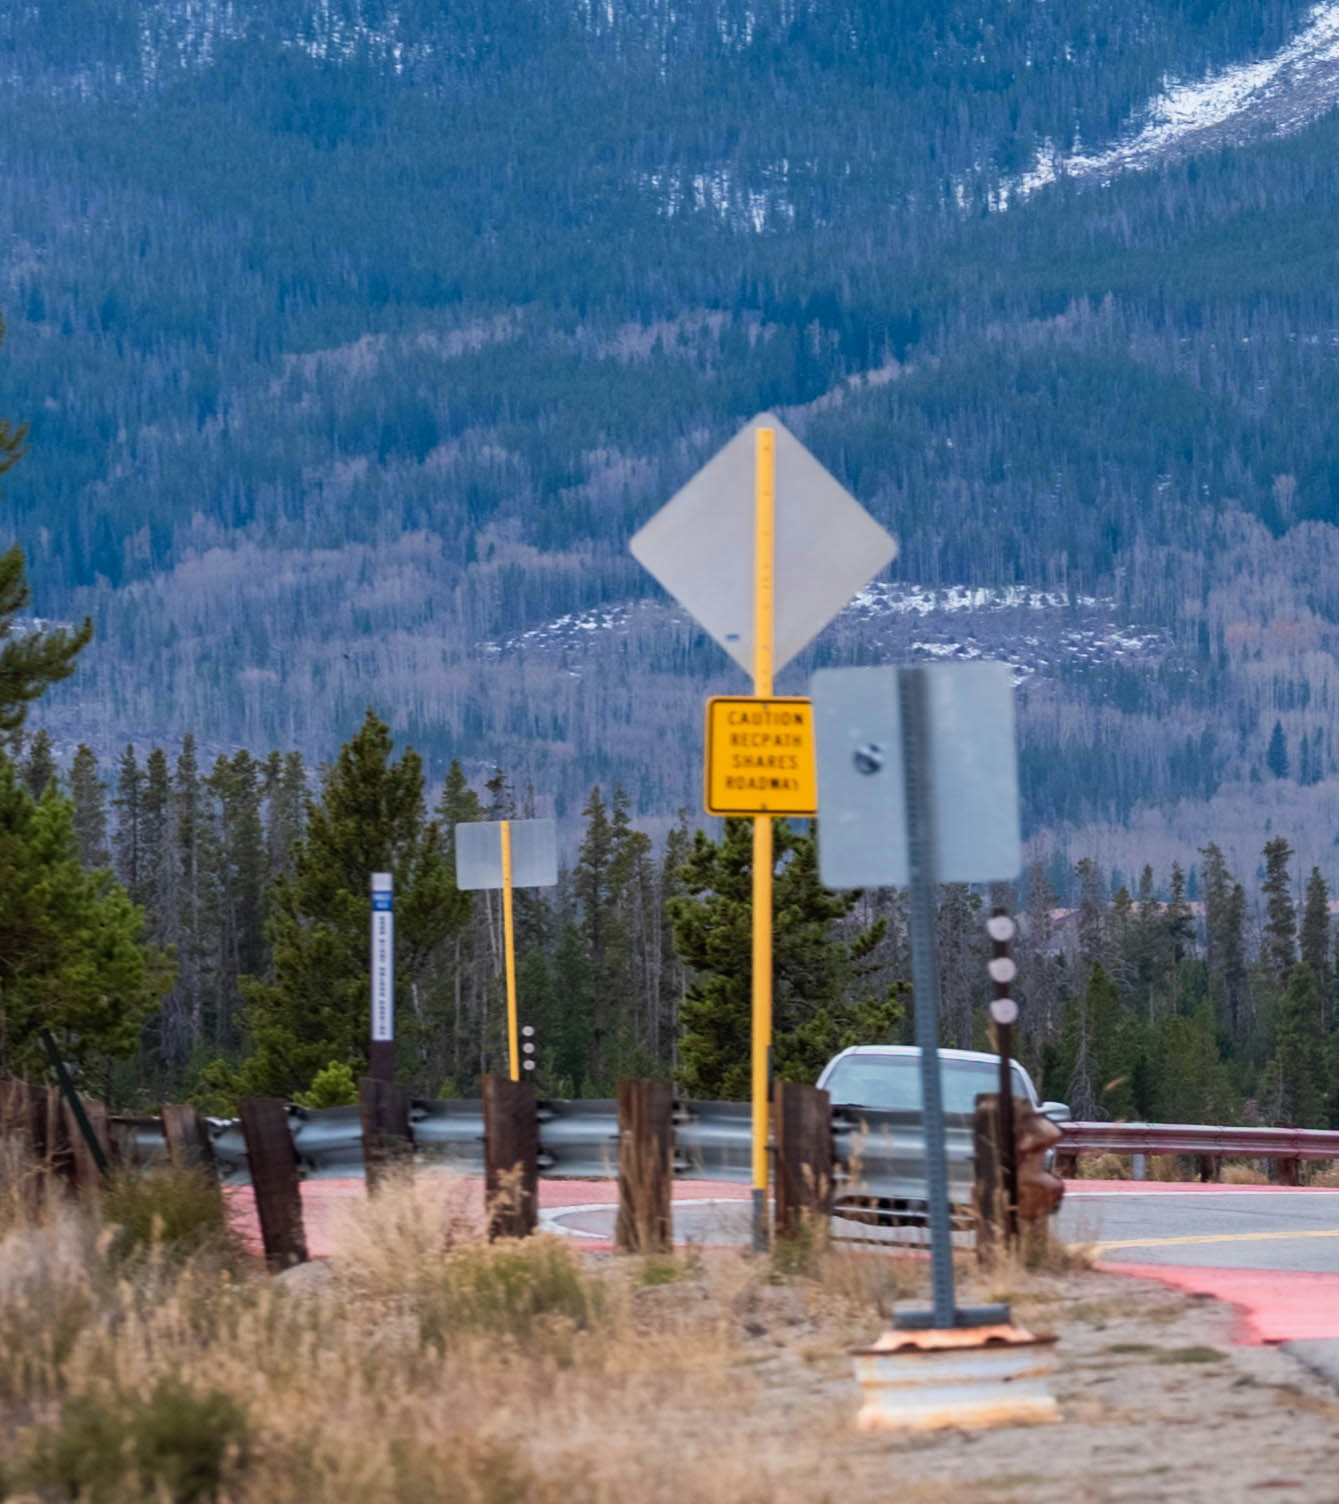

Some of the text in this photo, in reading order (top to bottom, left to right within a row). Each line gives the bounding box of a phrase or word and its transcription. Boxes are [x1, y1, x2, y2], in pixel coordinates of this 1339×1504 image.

[728, 711, 803, 726] CAUTION
[732, 753, 798, 769] SHARES
[726, 776, 799, 791] ROADWAY
